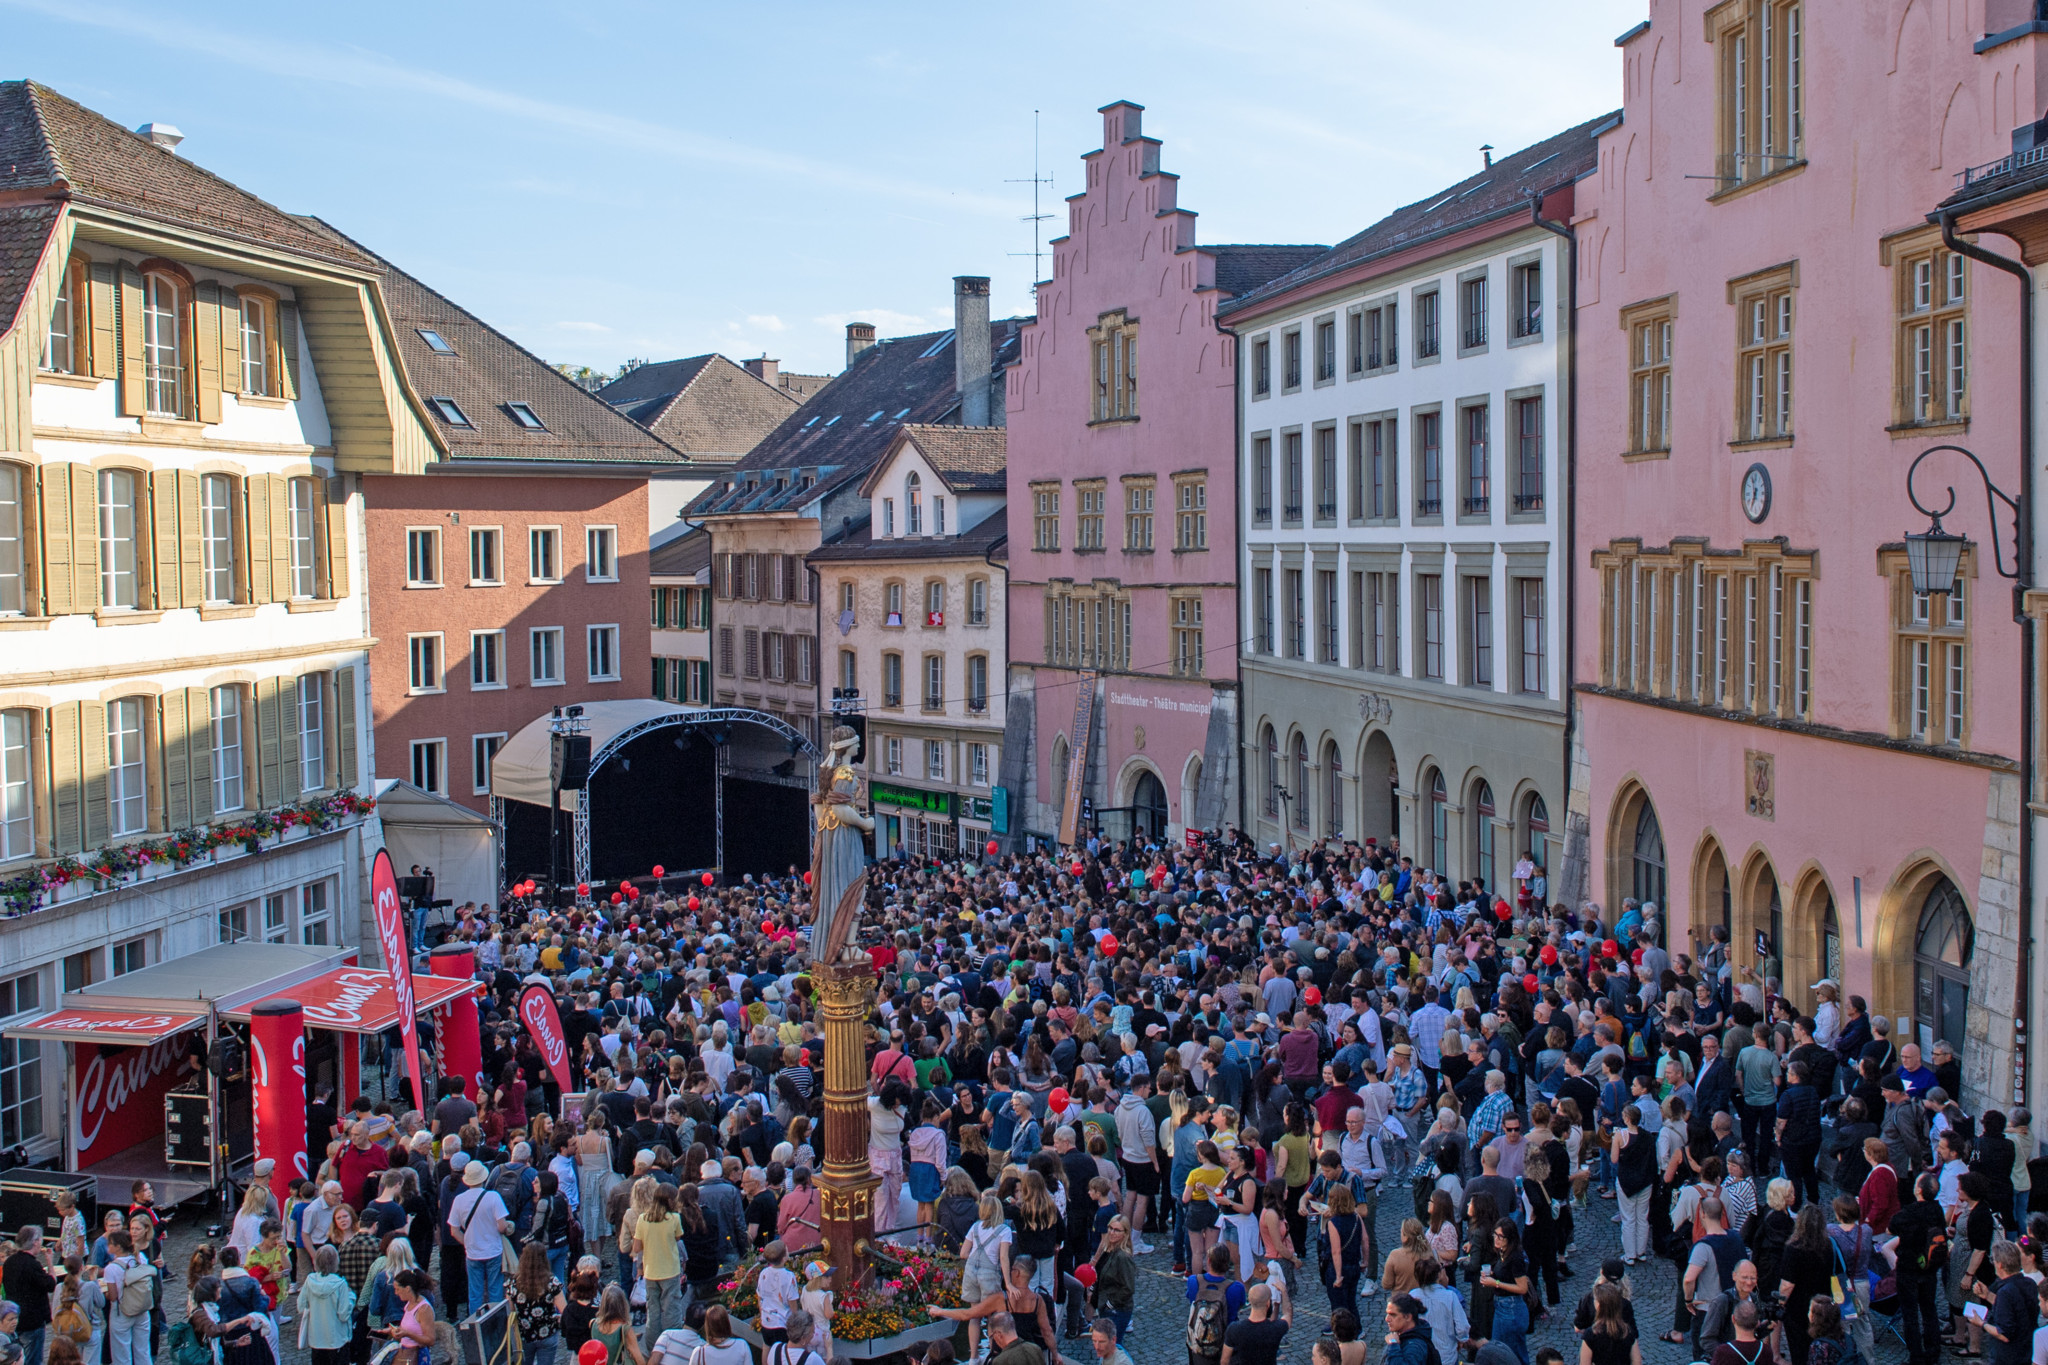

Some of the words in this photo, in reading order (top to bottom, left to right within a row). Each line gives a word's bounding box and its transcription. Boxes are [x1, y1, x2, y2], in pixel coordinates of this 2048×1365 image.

[1111, 692, 1149, 707] Stadttheater
[1154, 697, 1177, 711] Théâtre
[1180, 701, 1210, 716] municipal
[378, 887, 413, 1036] Canal3
[526, 995, 564, 1067] Canal3
